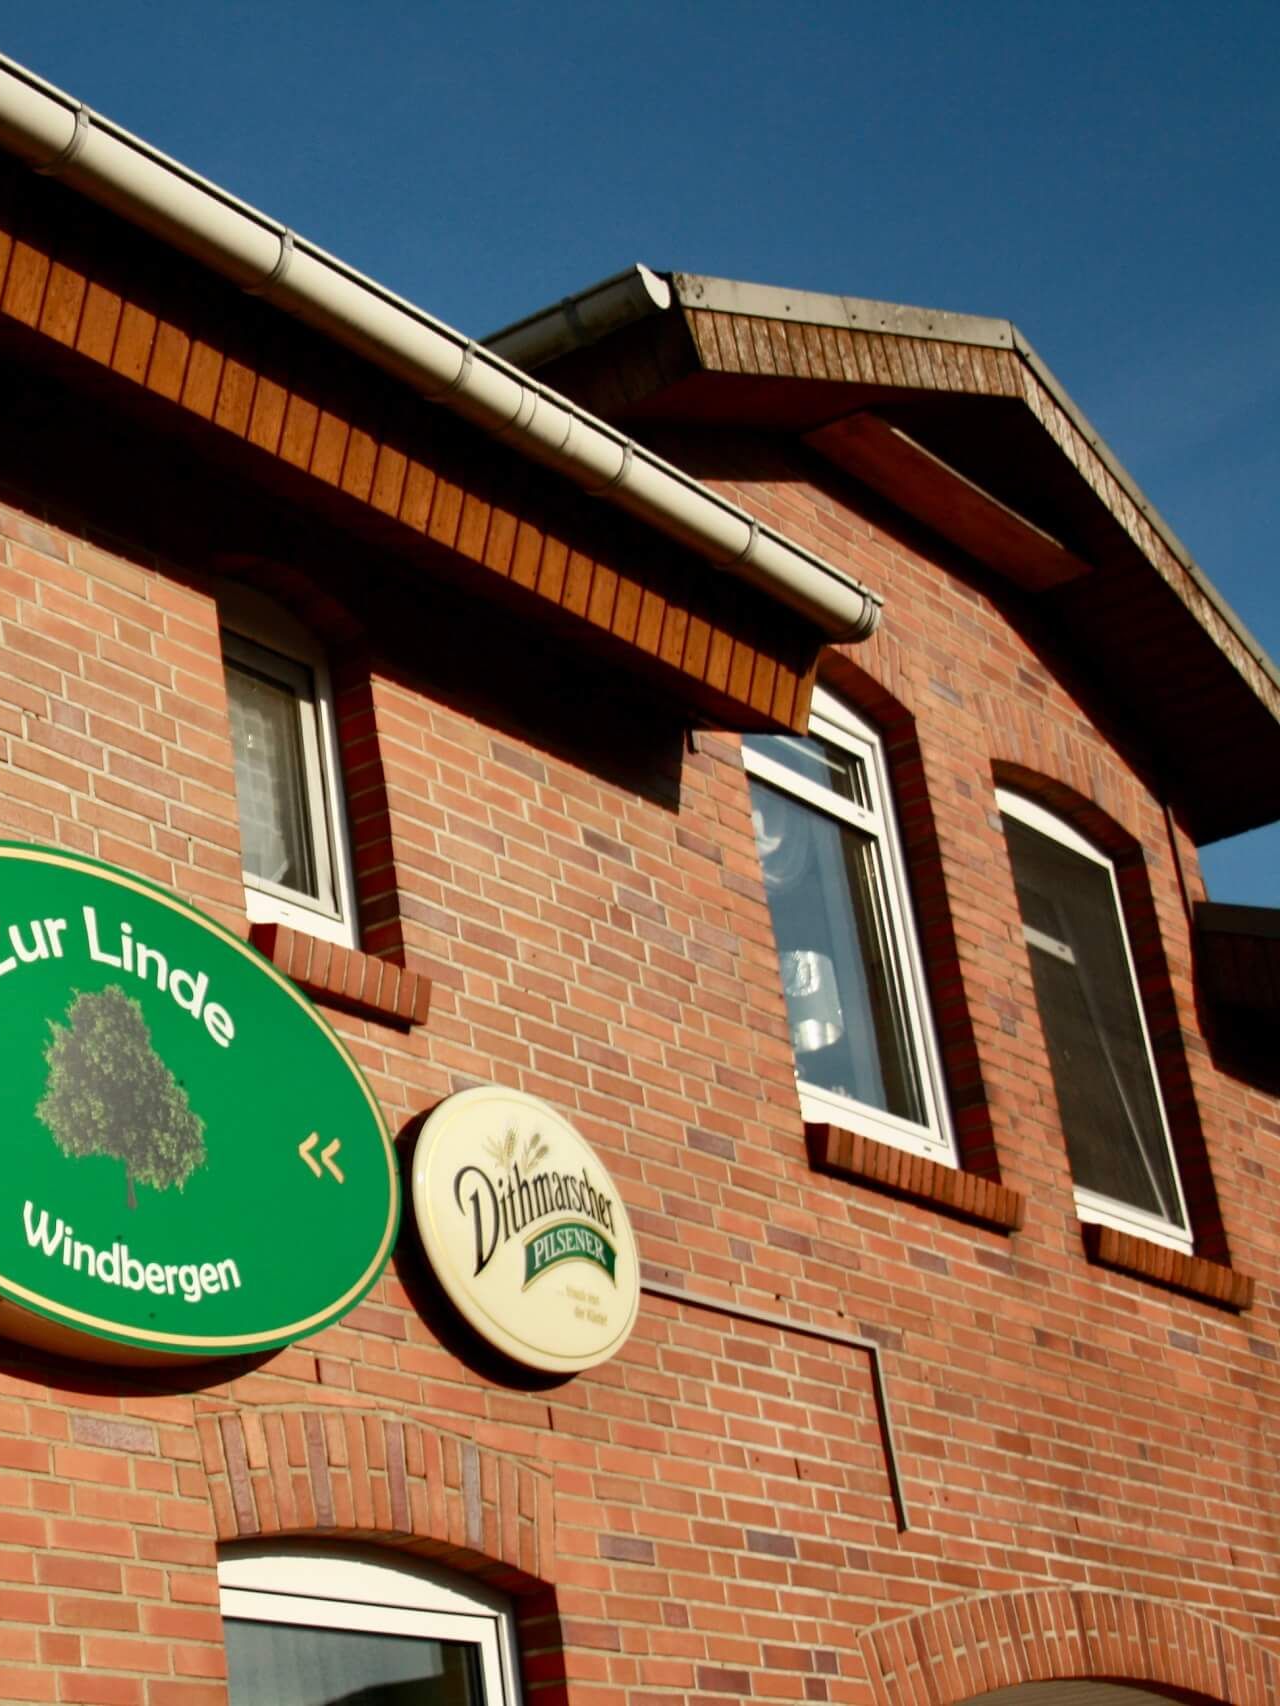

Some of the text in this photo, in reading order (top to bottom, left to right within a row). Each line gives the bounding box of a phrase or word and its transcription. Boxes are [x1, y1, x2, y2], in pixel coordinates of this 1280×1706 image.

[83, 905, 236, 1048] Linde
[22, 1200, 242, 1303] Windbergen
[453, 1160, 616, 1278] Dithmarscher
[534, 1227, 608, 1270] PILSENER
